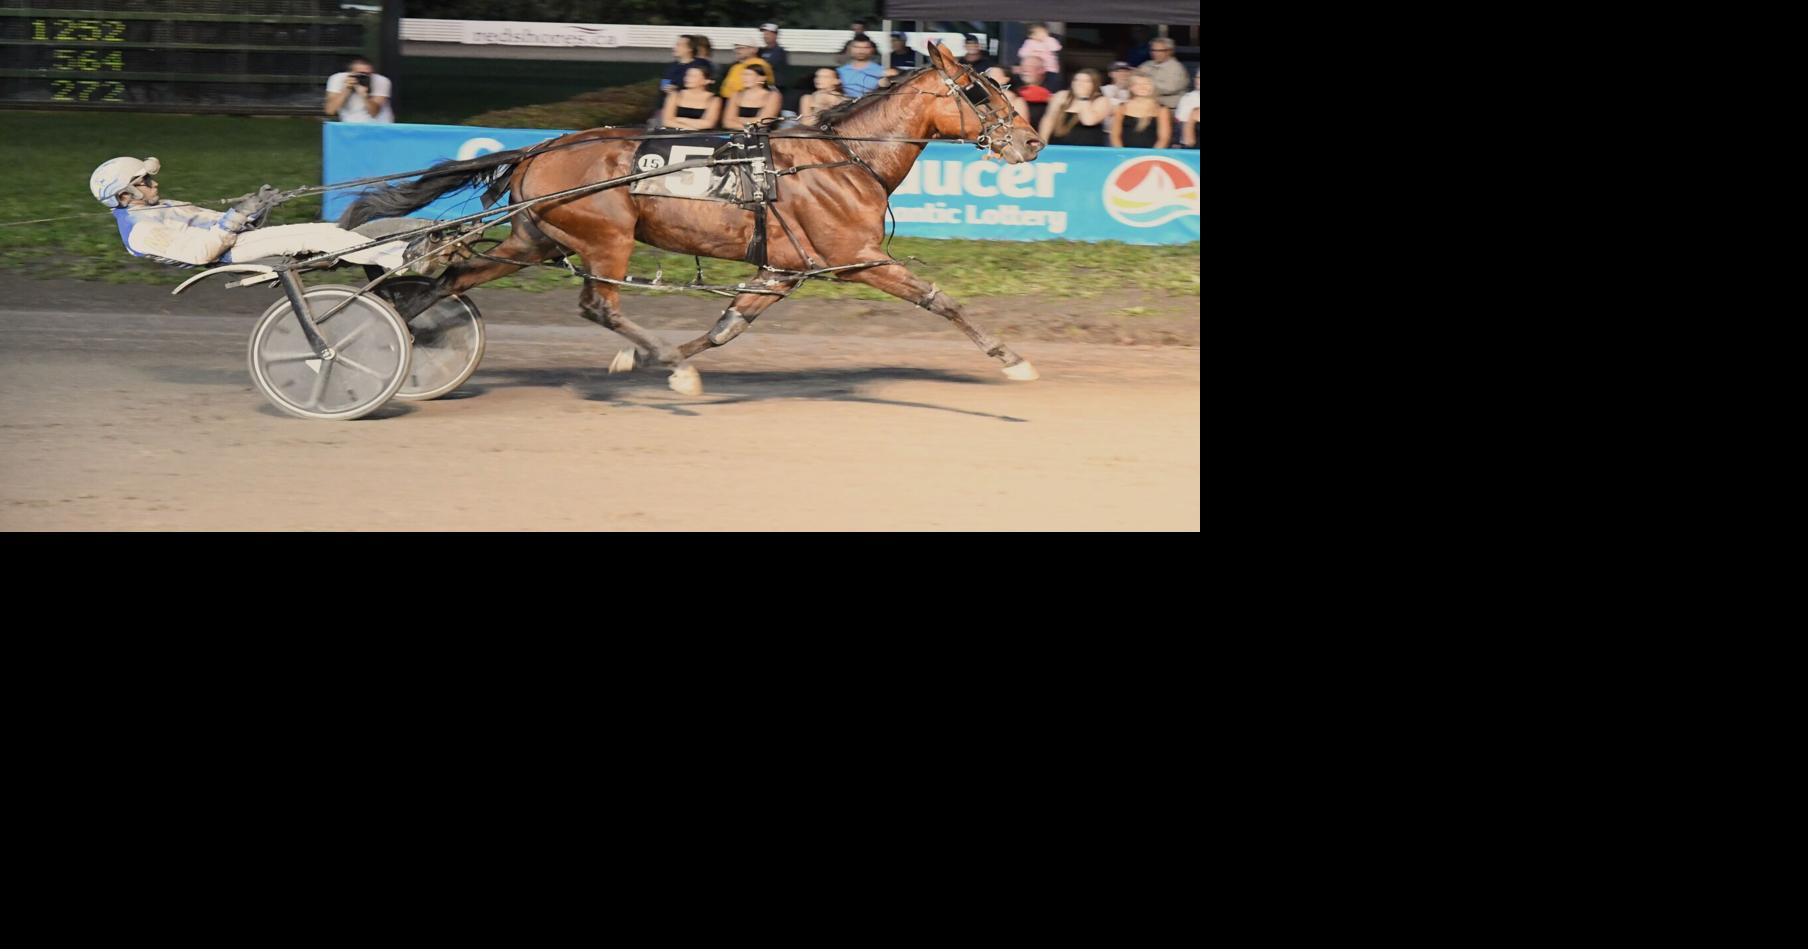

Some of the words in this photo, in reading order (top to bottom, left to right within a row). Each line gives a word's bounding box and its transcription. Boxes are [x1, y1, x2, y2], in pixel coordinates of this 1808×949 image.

[32, 19, 126, 41] 1252
[52, 49, 124, 71] 564
[51, 80, 125, 101] 272
[665, 145, 715, 197] 5
[965, 204, 1068, 233] Lottery
